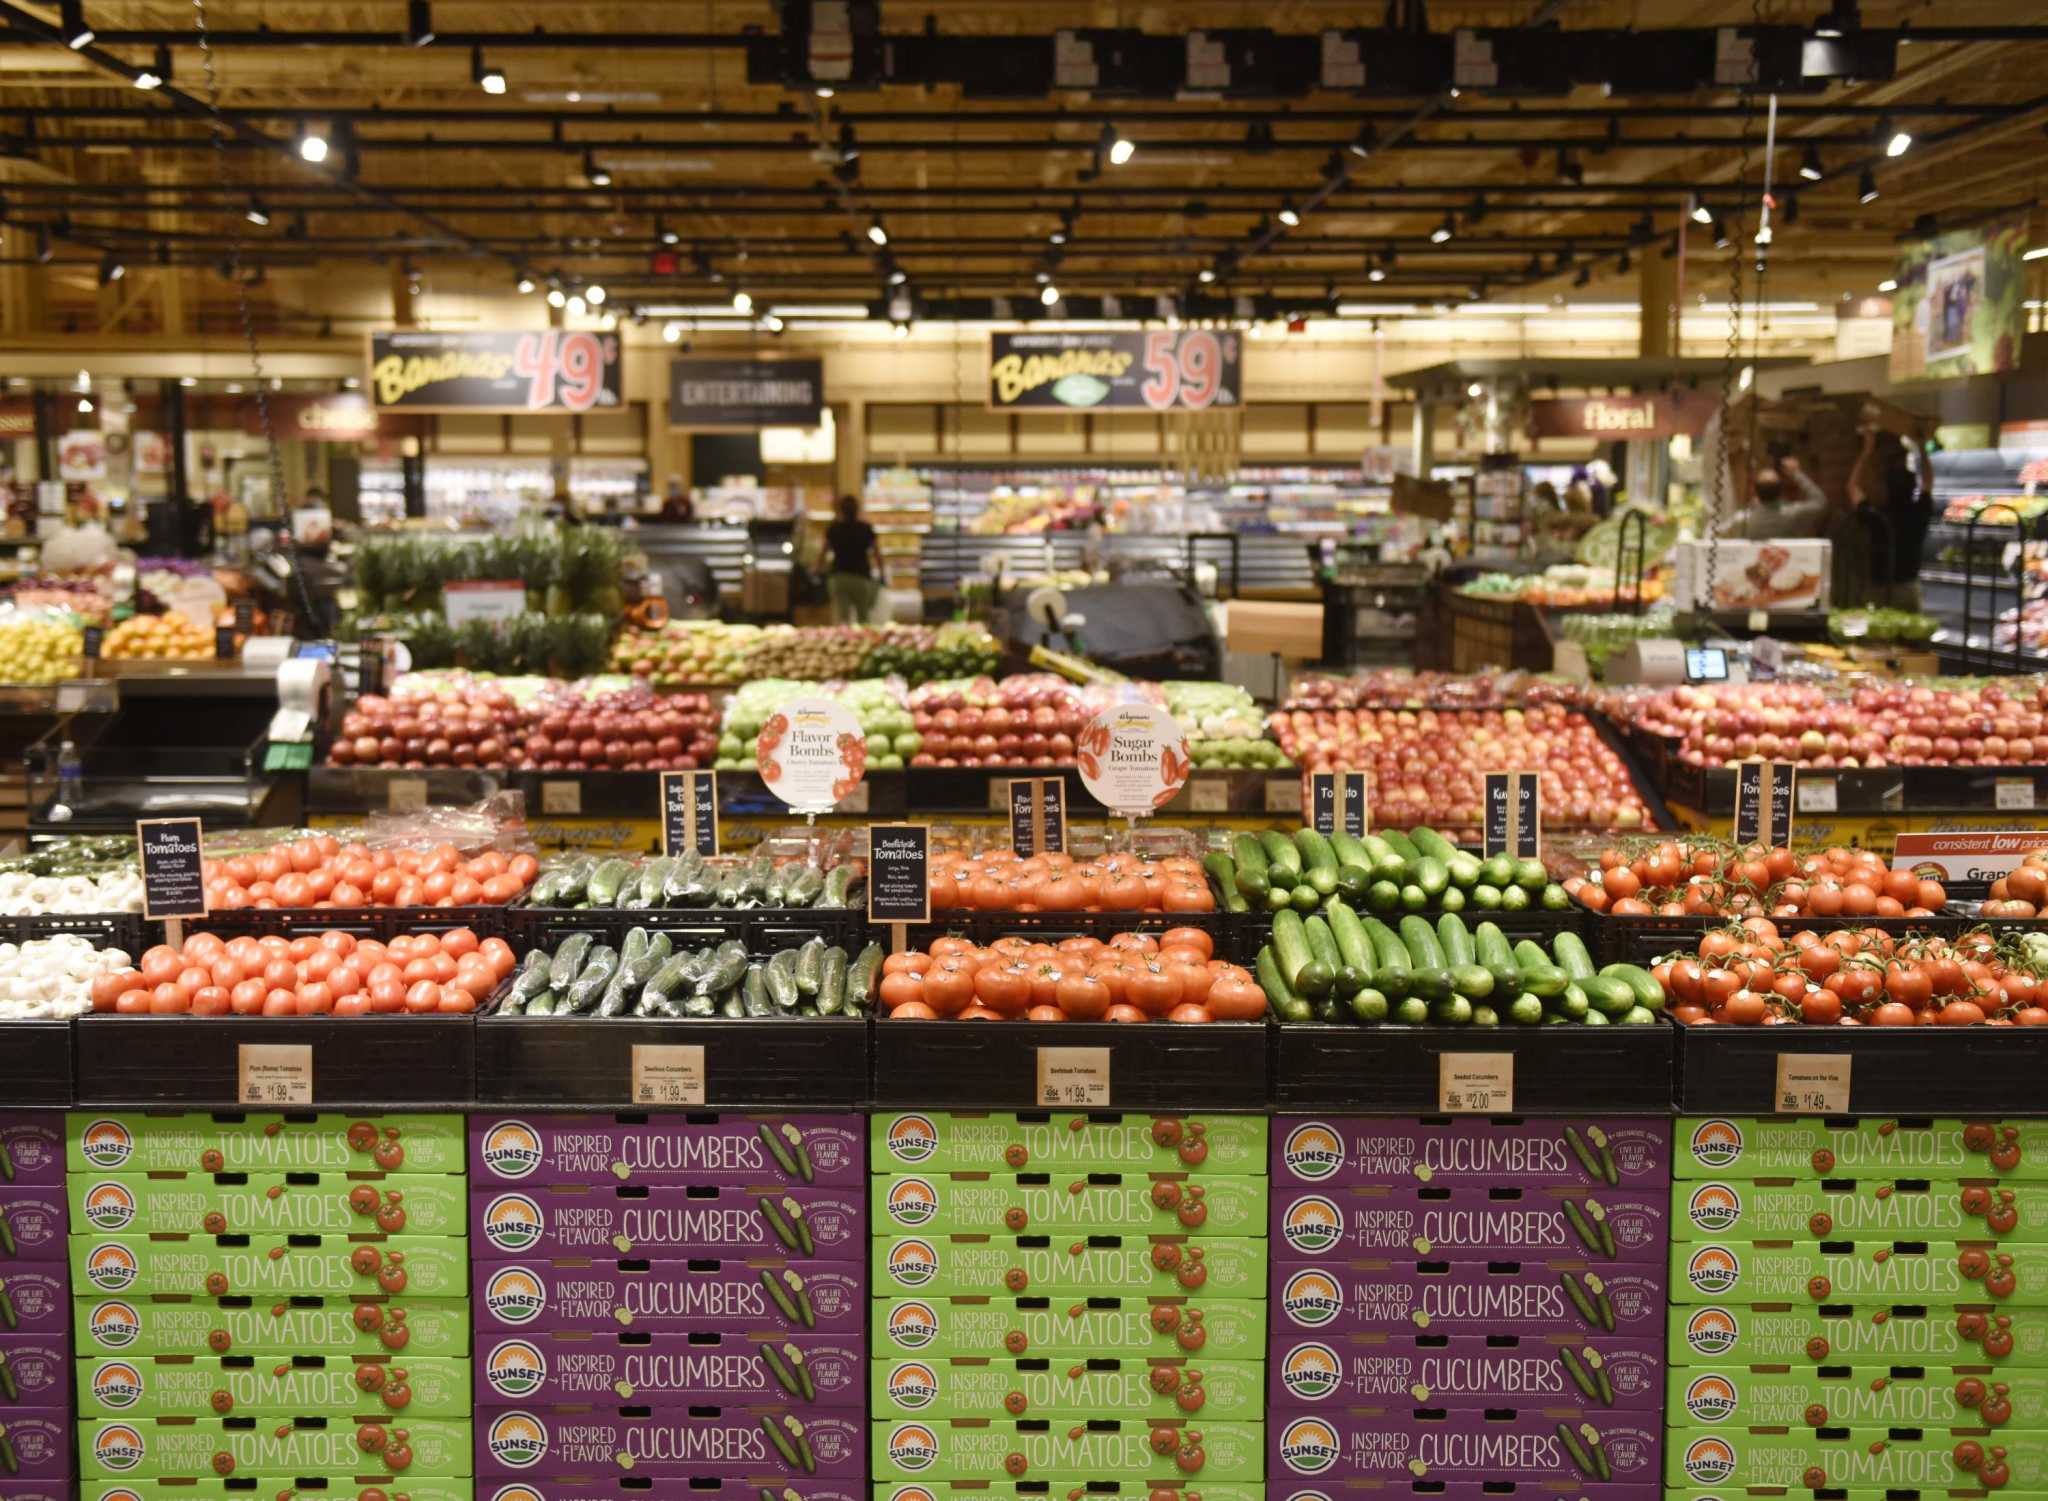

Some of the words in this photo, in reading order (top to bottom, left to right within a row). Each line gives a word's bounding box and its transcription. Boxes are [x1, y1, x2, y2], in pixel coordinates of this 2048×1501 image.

[992, 349, 1133, 403] Bananas
[792, 731, 833, 743] Flavor
[1113, 736, 1154, 751] Sugar
[790, 744, 835, 756] Bombs
[1111, 750, 1158, 762] Bombs
[144, 842, 197, 855] Tomatoes
[1932, 838, 1990, 850] consistent
[1991, 835, 2021, 850] low
[872, 848, 924, 860] Tomatoes
[889, 1137, 938, 1150] SUNSET
[949, 1126, 1008, 1143] INSPIRED
[1019, 1126, 1153, 1161] TOMATOES
[83, 1143, 132, 1156] SUNSET
[215, 1131, 349, 1166] TOMATOES
[554, 1135, 612, 1153] INSPIRED
[622, 1135, 764, 1170] CUCUMBERS
[954, 1144, 1004, 1162] FLAVOR
[1357, 1137, 1415, 1155] INSPIRED
[1693, 1142, 1742, 1155] SUNSET
[1828, 1131, 1962, 1166] TOMATOES
[150, 1150, 200, 1168] FLAVOR
[485, 1149, 541, 1163] SUNSET
[558, 1153, 609, 1172] FLAVOR
[1287, 1151, 1343, 1165] SUNSET
[1360, 1155, 1411, 1174] FLAVOR
[1426, 1138, 1568, 1173] CUCUMBERS
[147, 1194, 206, 1211] INSPIRED
[949, 1189, 1008, 1206] INSPIRED
[1019, 1188, 1153, 1223] TOMATOES
[1753, 1195, 1812, 1212] INSPIRED
[86, 1205, 135, 1218] SUNSET
[217, 1193, 351, 1228] TOMATOES
[889, 1201, 938, 1214] SUNSET
[1691, 1206, 1740, 1219] SUNSET
[1825, 1194, 1959, 1229] TOMATOES
[152, 1212, 202, 1230] FLAVOR
[555, 1208, 613, 1226] INSPIRED
[954, 1208, 1004, 1226] FLAVOR
[1355, 1210, 1413, 1228] INSPIRED
[1757, 1213, 1807, 1231] FLAVOR
[486, 1222, 542, 1236] SUNSET
[559, 1226, 610, 1245] FLAVOR
[623, 1209, 765, 1244] CUCUMBERS
[1286, 1224, 1342, 1238] SUNSET
[1424, 1211, 1566, 1246] CUCUMBERS
[1359, 1228, 1410, 1247] FLAVOR
[149, 1255, 208, 1272] INSPIRED
[949, 1250, 1008, 1267] INSPIRED
[1019, 1250, 1153, 1285] TOMATOES
[1752, 1258, 1811, 1275] INSPIRED
[88, 1266, 137, 1279] SUNSET
[219, 1254, 353, 1289] TOMATOES
[889, 1262, 938, 1275] SUNSET
[1689, 1269, 1738, 1282] SUNSET
[1824, 1257, 1958, 1292] TOMATOES
[154, 1273, 204, 1291] FLAVOR
[954, 1269, 1004, 1287] FLAVOR
[1756, 1276, 1806, 1294] FLAVOR
[557, 1281, 615, 1299] INSPIRED
[624, 1281, 766, 1316] CUCUMBERS
[1355, 1284, 1413, 1302] INSPIRED
[488, 1295, 544, 1309] SUNSET
[561, 1299, 612, 1318] FLAVOR
[1285, 1298, 1341, 1312] SUNSET
[1423, 1284, 1565, 1319] CUCUMBERS
[152, 1312, 211, 1329] INSPIRED
[1358, 1302, 1409, 1321] FLAVOR
[91, 1323, 140, 1336] SUNSET
[221, 1311, 355, 1346] TOMATOES
[889, 1324, 938, 1337] SUNSET
[949, 1313, 1008, 1330] INSPIRED
[1018, 1312, 1152, 1347] TOMATOES
[1751, 1319, 1810, 1336] INSPIRED
[157, 1330, 207, 1348] FLAVOR
[954, 1331, 1004, 1349] FLAVOR
[1688, 1330, 1737, 1343] SUNSET
[1822, 1319, 1956, 1354] TOMATOES
[1754, 1337, 1804, 1355] FLAVOR
[557, 1354, 615, 1372] INSPIRED
[624, 1354, 766, 1389] CUCUMBERS
[1354, 1357, 1412, 1375] INSPIRED
[154, 1373, 213, 1390] INSPIRED
[489, 1368, 545, 1382] SUNSET
[561, 1372, 612, 1391] FLAVOR
[949, 1374, 1008, 1391] INSPIRED
[1285, 1371, 1341, 1385] SUNSET
[1422, 1358, 1564, 1393] CUCUMBERS
[94, 1384, 143, 1397] SUNSET
[223, 1371, 357, 1406] TOMATOES
[889, 1385, 938, 1398] SUNSET
[1018, 1373, 1152, 1408] TOMATOES
[1357, 1375, 1408, 1394] FLAVOR
[159, 1390, 209, 1408] FLAVOR
[954, 1392, 1004, 1410] FLAVOR
[1687, 1397, 1736, 1410] SUNSET
[1749, 1386, 1808, 1403] INSPIRED
[1820, 1385, 1954, 1420] TOMATOES
[1753, 1404, 1803, 1422] FLAVOR
[156, 1435, 215, 1452] INSPIRED
[559, 1426, 617, 1444] INSPIRED
[625, 1426, 767, 1461] CUCUMBERS
[949, 1435, 1008, 1452] INSPIRED
[1352, 1432, 1410, 1450] INSPIRED
[95, 1446, 144, 1459] SUNSET
[225, 1432, 359, 1467] TOMATOES
[491, 1439, 547, 1453] SUNSET
[563, 1444, 614, 1463] FLAVOR
[889, 1446, 938, 1459] SUNSET
[1018, 1434, 1152, 1469] TOMATOES
[1283, 1445, 1339, 1459] SUNSET
[1419, 1433, 1561, 1468] CUCUMBERS
[161, 1452, 211, 1470] FLAVOR
[954, 1453, 1004, 1471] FLAVOR
[1355, 1450, 1406, 1469] FLAVOR
[1686, 1459, 1735, 1472] SUNSET
[1748, 1449, 1807, 1466] INSPIRED
[1818, 1448, 1952, 1483] TOMATOES
